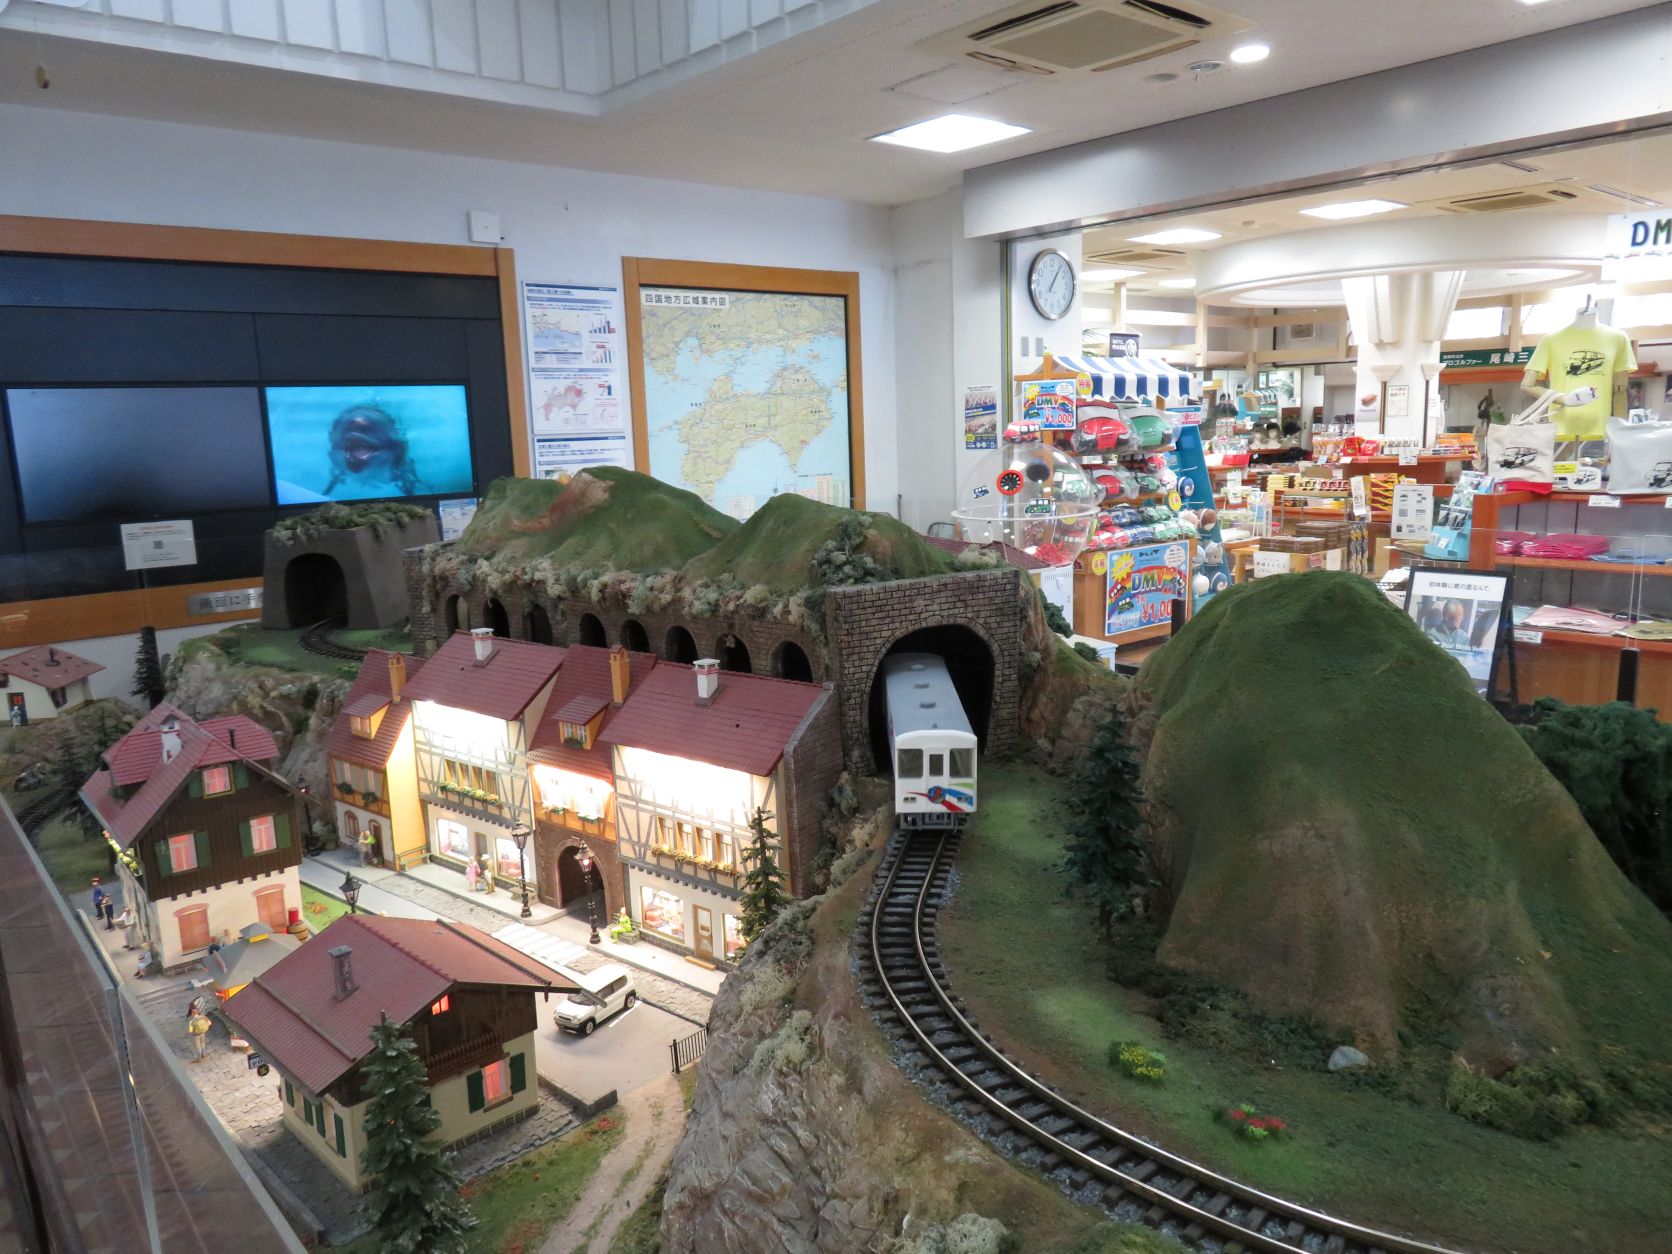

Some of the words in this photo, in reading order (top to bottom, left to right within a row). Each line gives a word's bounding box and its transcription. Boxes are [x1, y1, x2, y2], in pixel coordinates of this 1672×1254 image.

[645, 293, 727, 306] 四国地方広域案内図
[1045, 413, 1072, 424] ¥1,000
[1130, 567, 1166, 594] DMV
[1141, 598, 1172, 622] ¥1,00
